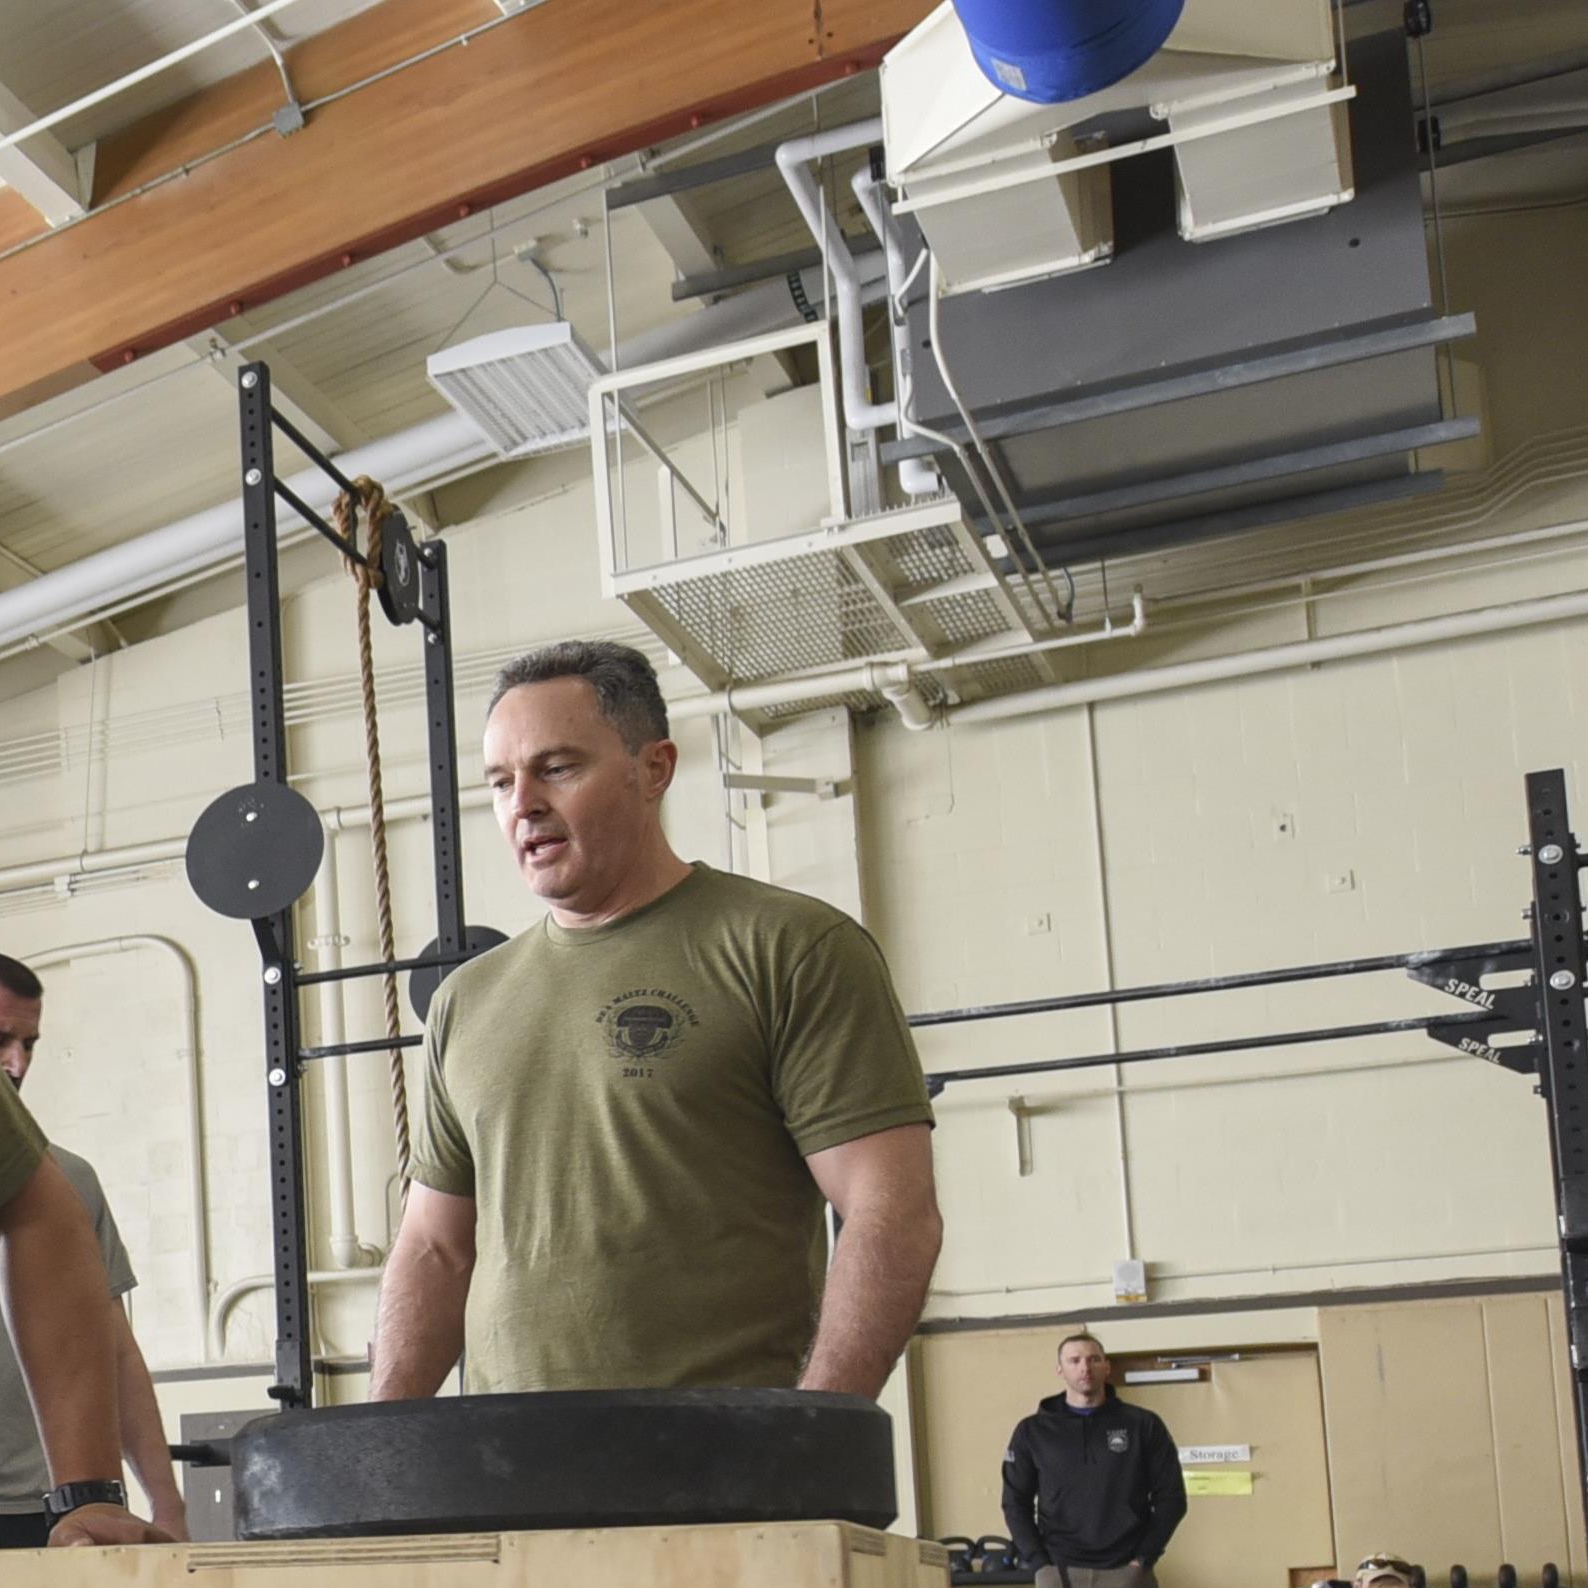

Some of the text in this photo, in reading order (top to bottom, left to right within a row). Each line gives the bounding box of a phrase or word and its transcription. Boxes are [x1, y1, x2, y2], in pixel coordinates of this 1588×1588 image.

[1444, 978, 1496, 1010] SPEAL
[1458, 1037, 1502, 1064] SPEAL
[622, 1067, 655, 1079] 2017
[1190, 1449, 1239, 1463] Storage
